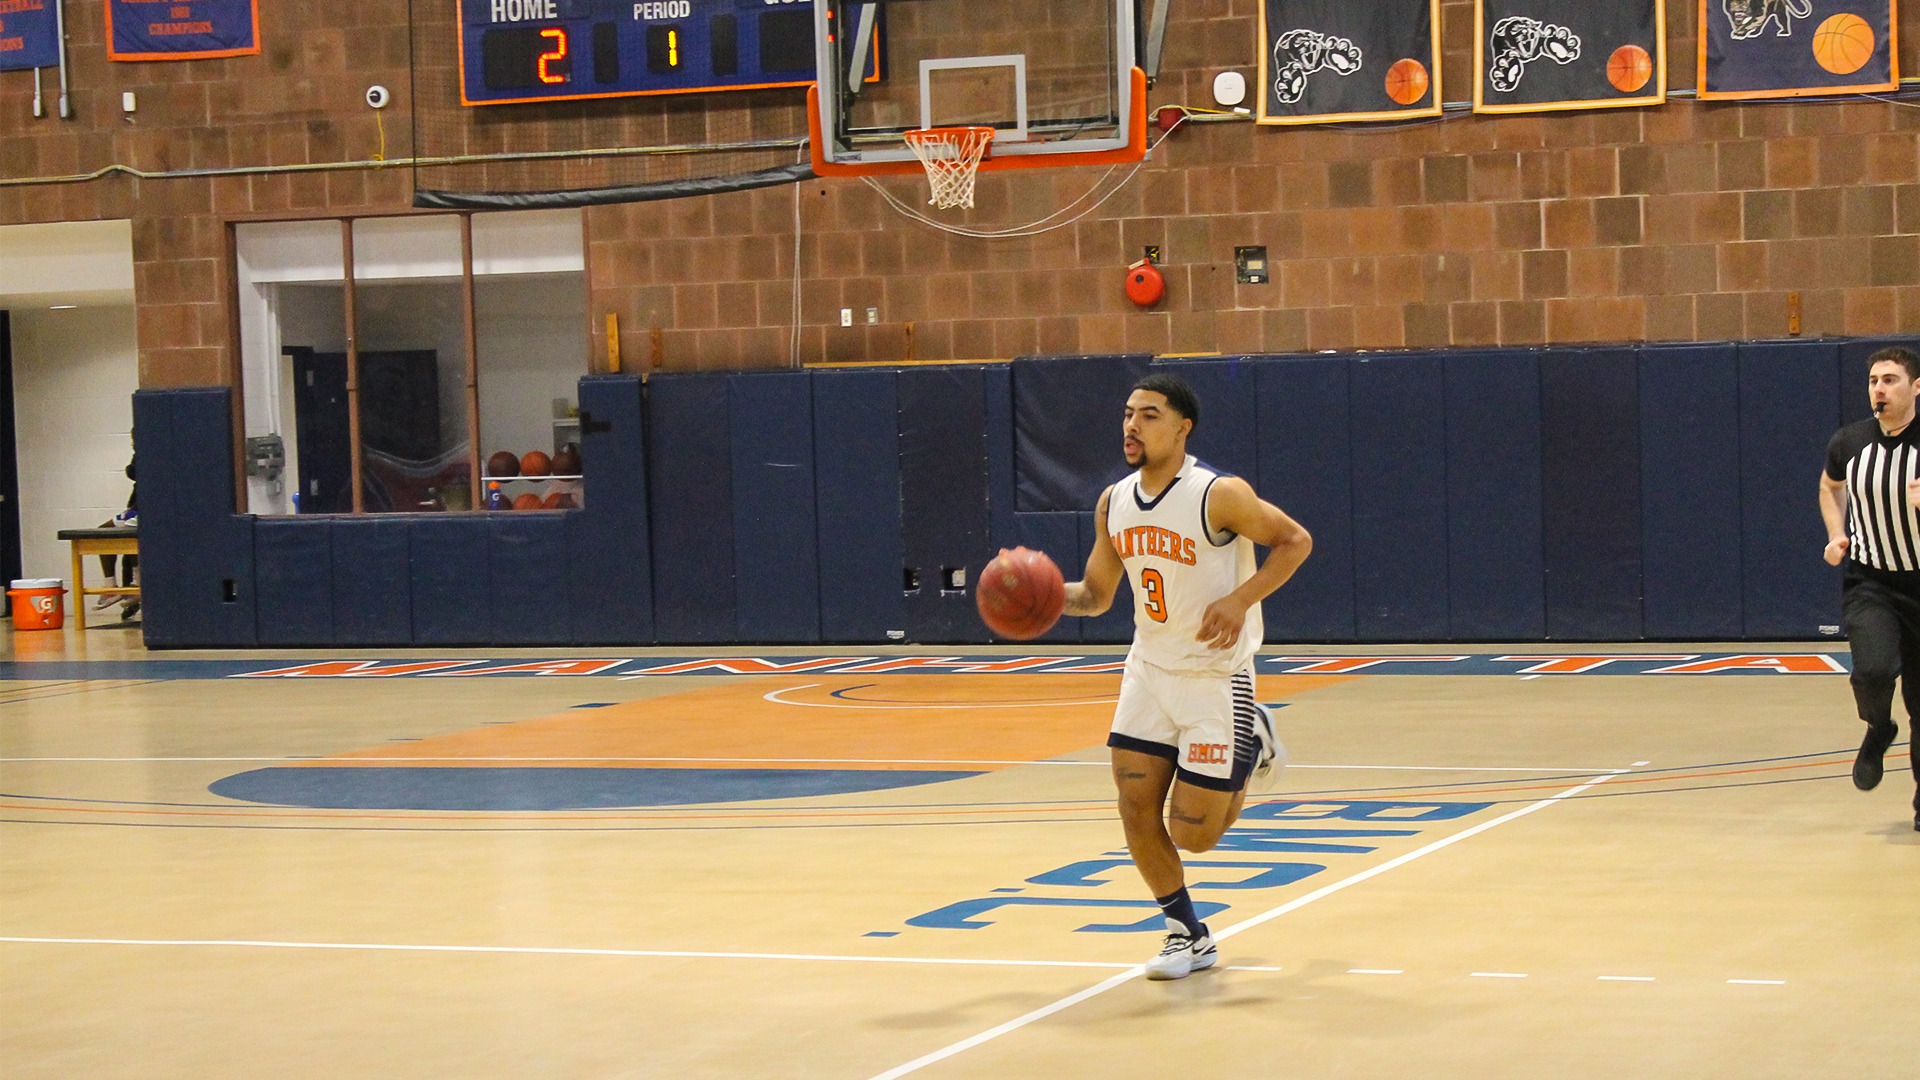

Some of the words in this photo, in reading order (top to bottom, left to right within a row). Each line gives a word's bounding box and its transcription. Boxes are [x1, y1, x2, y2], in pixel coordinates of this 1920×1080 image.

[490, 0, 558, 23] HOME
[633, 0, 691, 20] PERIOD
[537, 28, 568, 84] 2
[668, 30, 678, 67] 1
[1141, 567, 1168, 624] 3
[1187, 743, 1229, 764] BMCC
